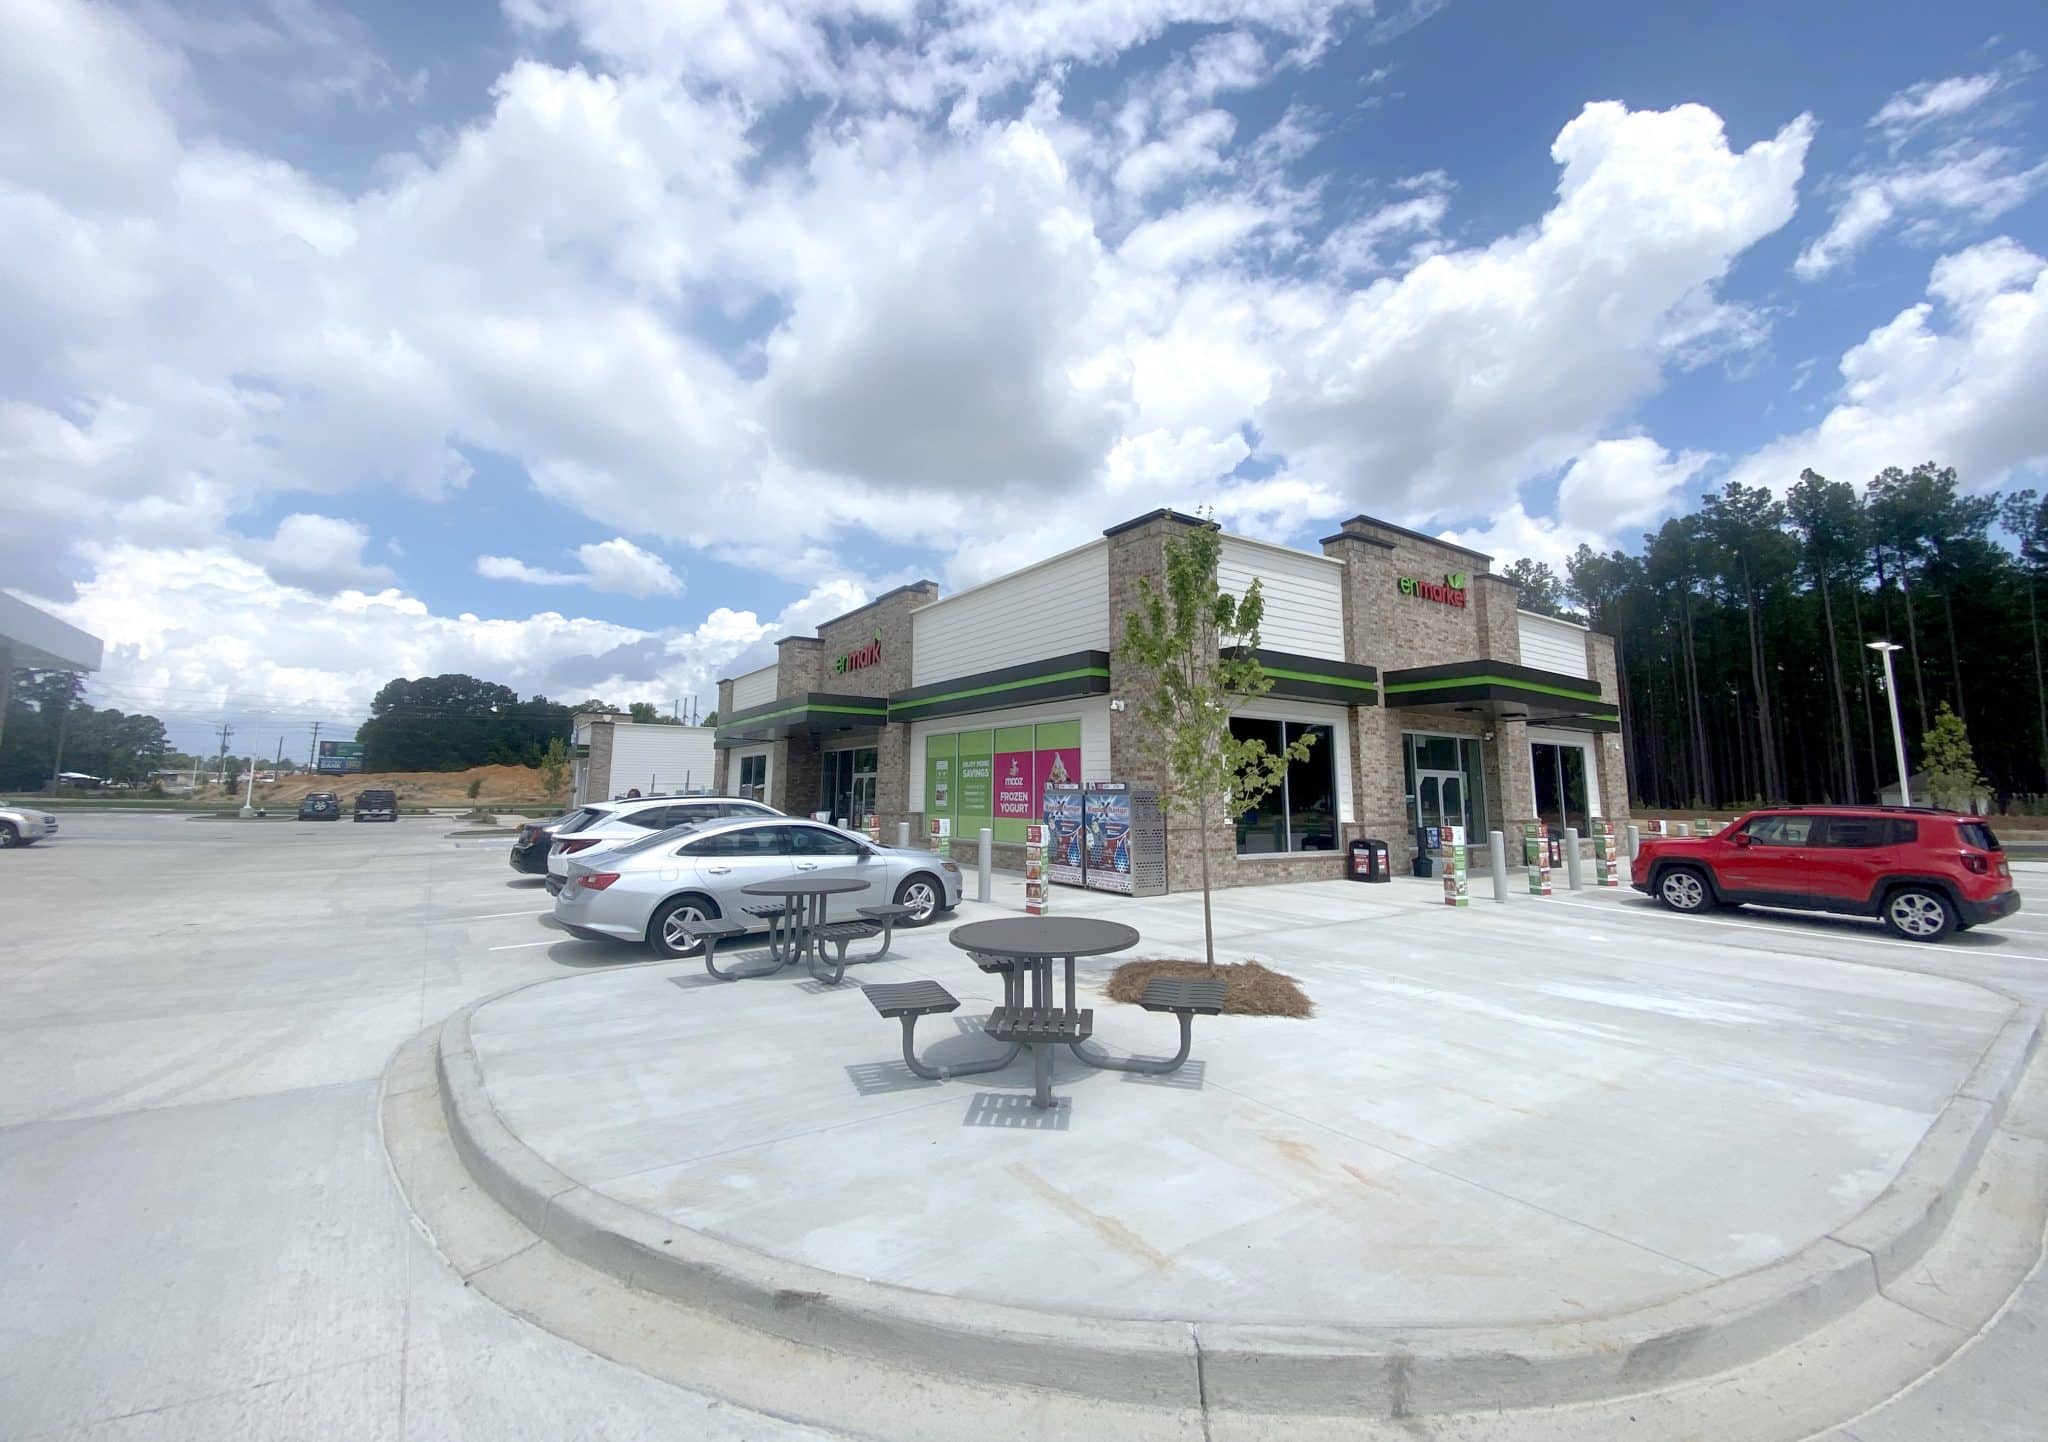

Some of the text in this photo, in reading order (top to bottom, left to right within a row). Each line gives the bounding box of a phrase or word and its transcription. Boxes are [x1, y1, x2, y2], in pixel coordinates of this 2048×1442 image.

[962, 768, 990, 778] SAVINGS
[1005, 777, 1024, 786] mooz
[1000, 791, 1028, 801] FROZEN
[1000, 803, 1029, 814] YOGURT
